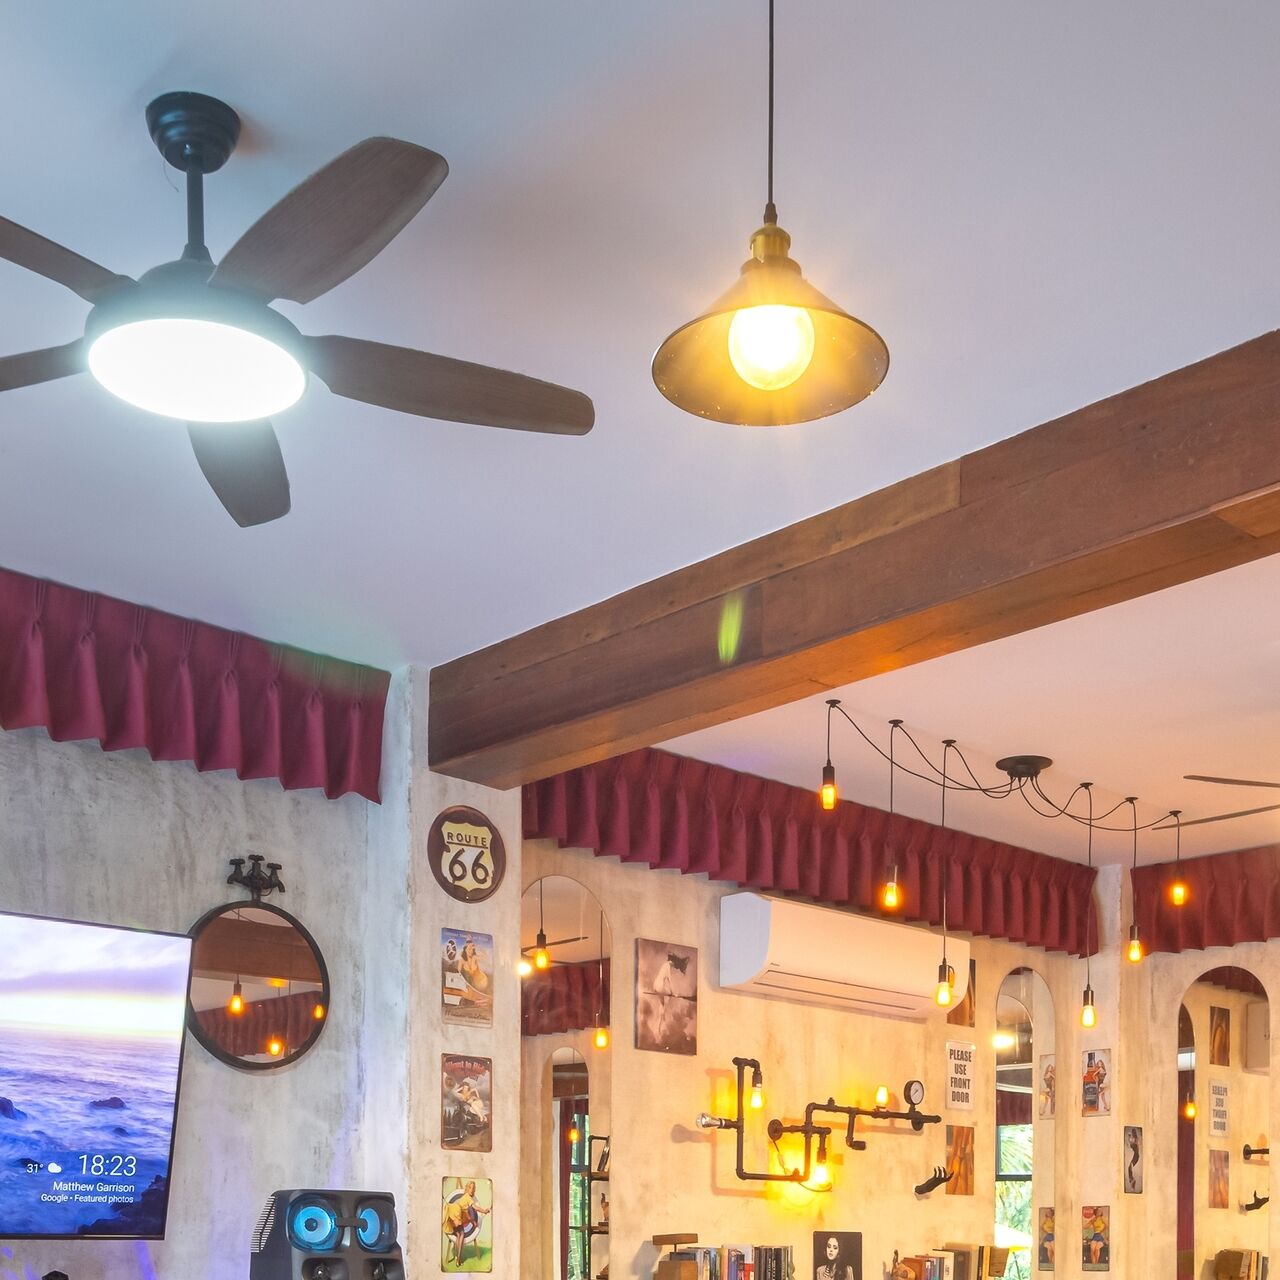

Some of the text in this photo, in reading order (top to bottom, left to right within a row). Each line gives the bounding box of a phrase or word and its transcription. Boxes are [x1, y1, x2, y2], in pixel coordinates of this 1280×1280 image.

[447, 832, 487, 846] ROUTE
[449, 848, 489, 884] 66
[950, 1049, 972, 1062] PLEASE
[954, 1064, 966, 1075] USE
[950, 1076, 971, 1089] FRONT
[952, 1091, 969, 1103] DOOR
[78, 1154, 137, 1176] 18:23
[53, 1181, 135, 1193] Matthew Garrison
[41, 1194, 134, 1204] Google Featured photos
